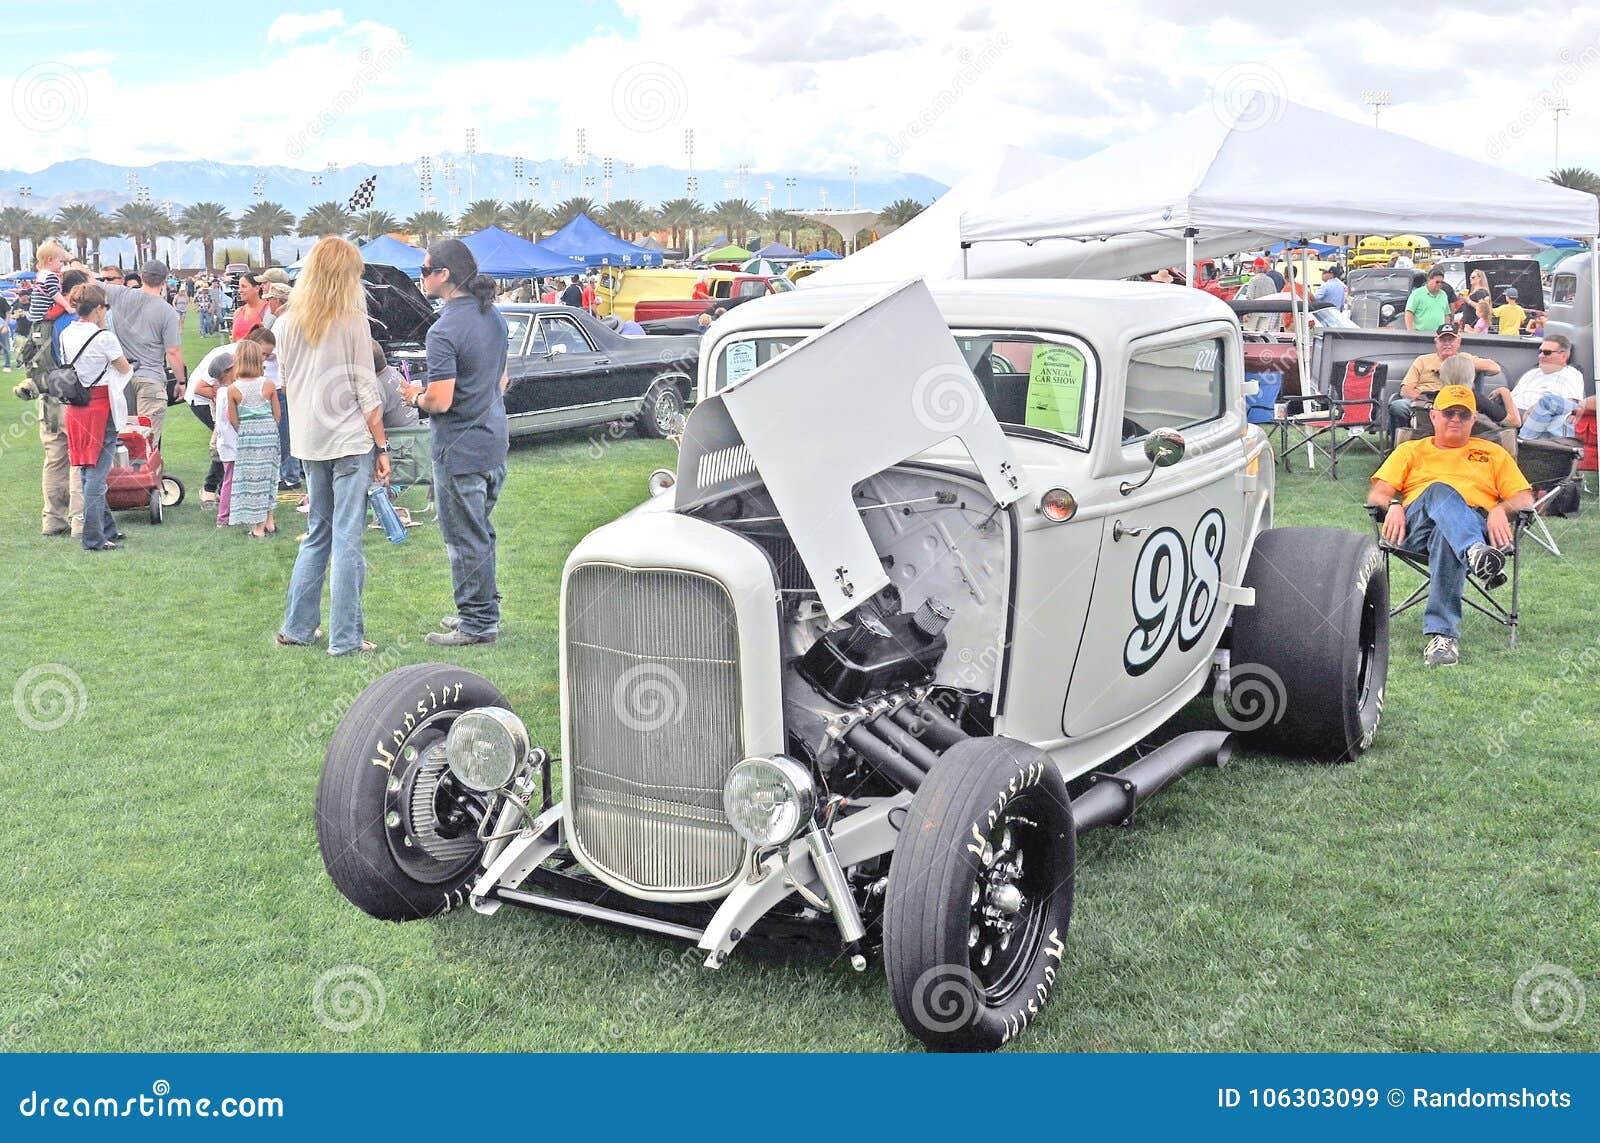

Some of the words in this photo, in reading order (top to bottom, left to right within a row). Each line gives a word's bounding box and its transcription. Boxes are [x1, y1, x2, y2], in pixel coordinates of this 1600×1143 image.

[1040, 368, 1072, 378] ANNUAL
[1035, 375, 1051, 383] CAR
[1052, 376, 1076, 385] SHOW
[1123, 508, 1226, 677] 98
